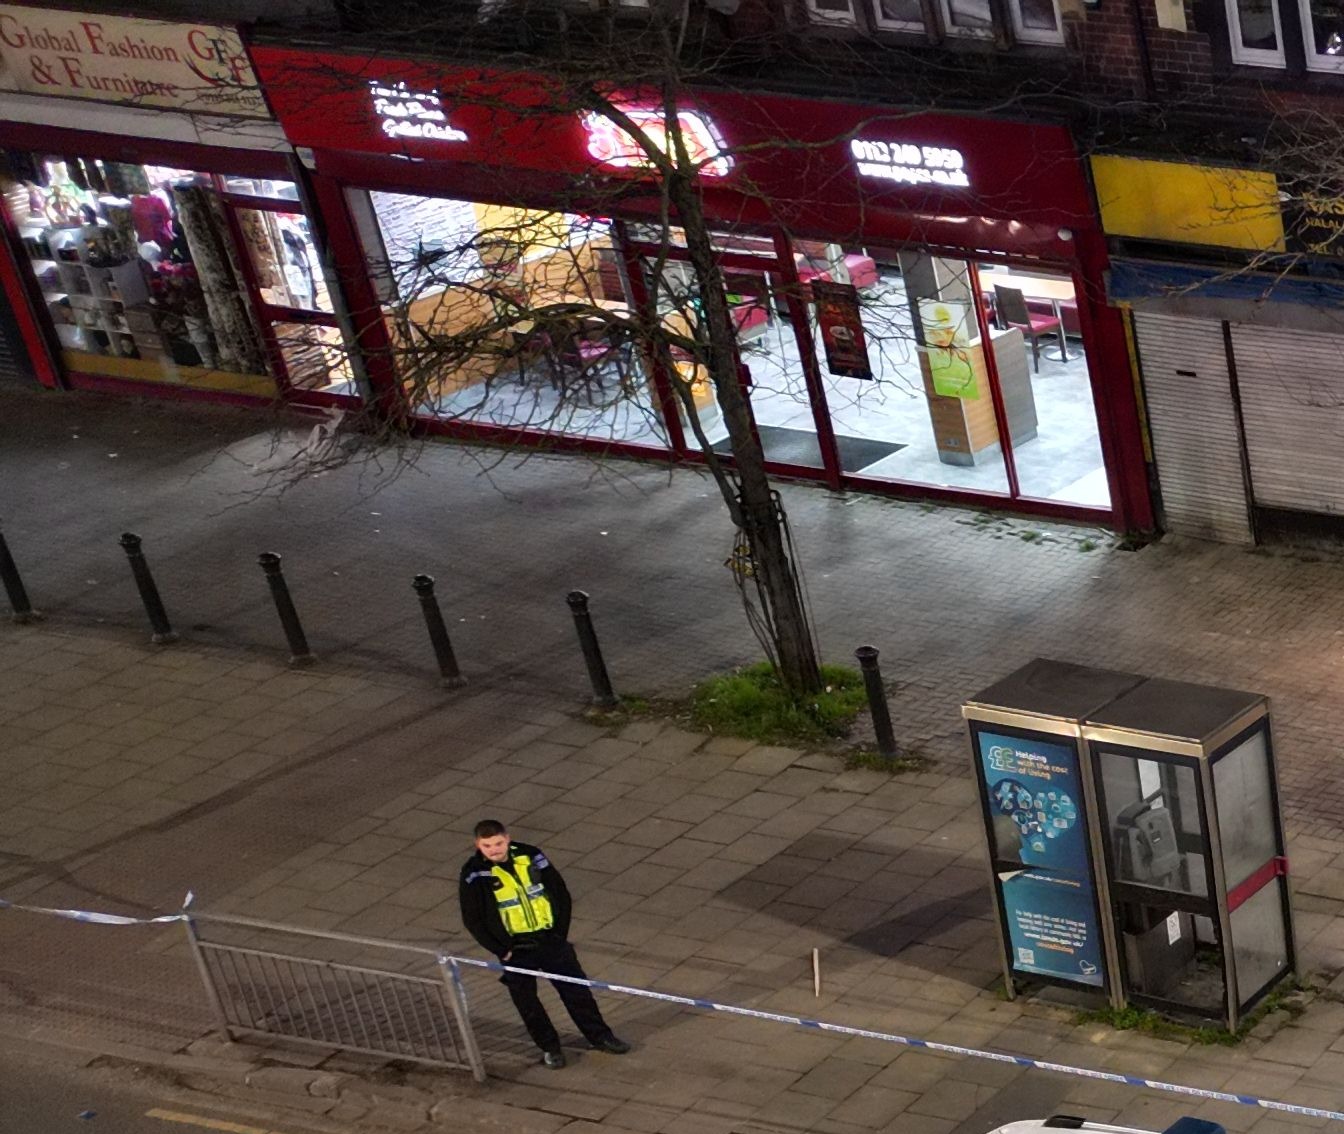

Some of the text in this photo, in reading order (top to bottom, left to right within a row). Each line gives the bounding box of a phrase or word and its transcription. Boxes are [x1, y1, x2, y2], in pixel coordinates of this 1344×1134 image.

[0, 14, 81, 53] Global
[80, 21, 180, 63] Fashion
[30, 55, 62, 85] &
